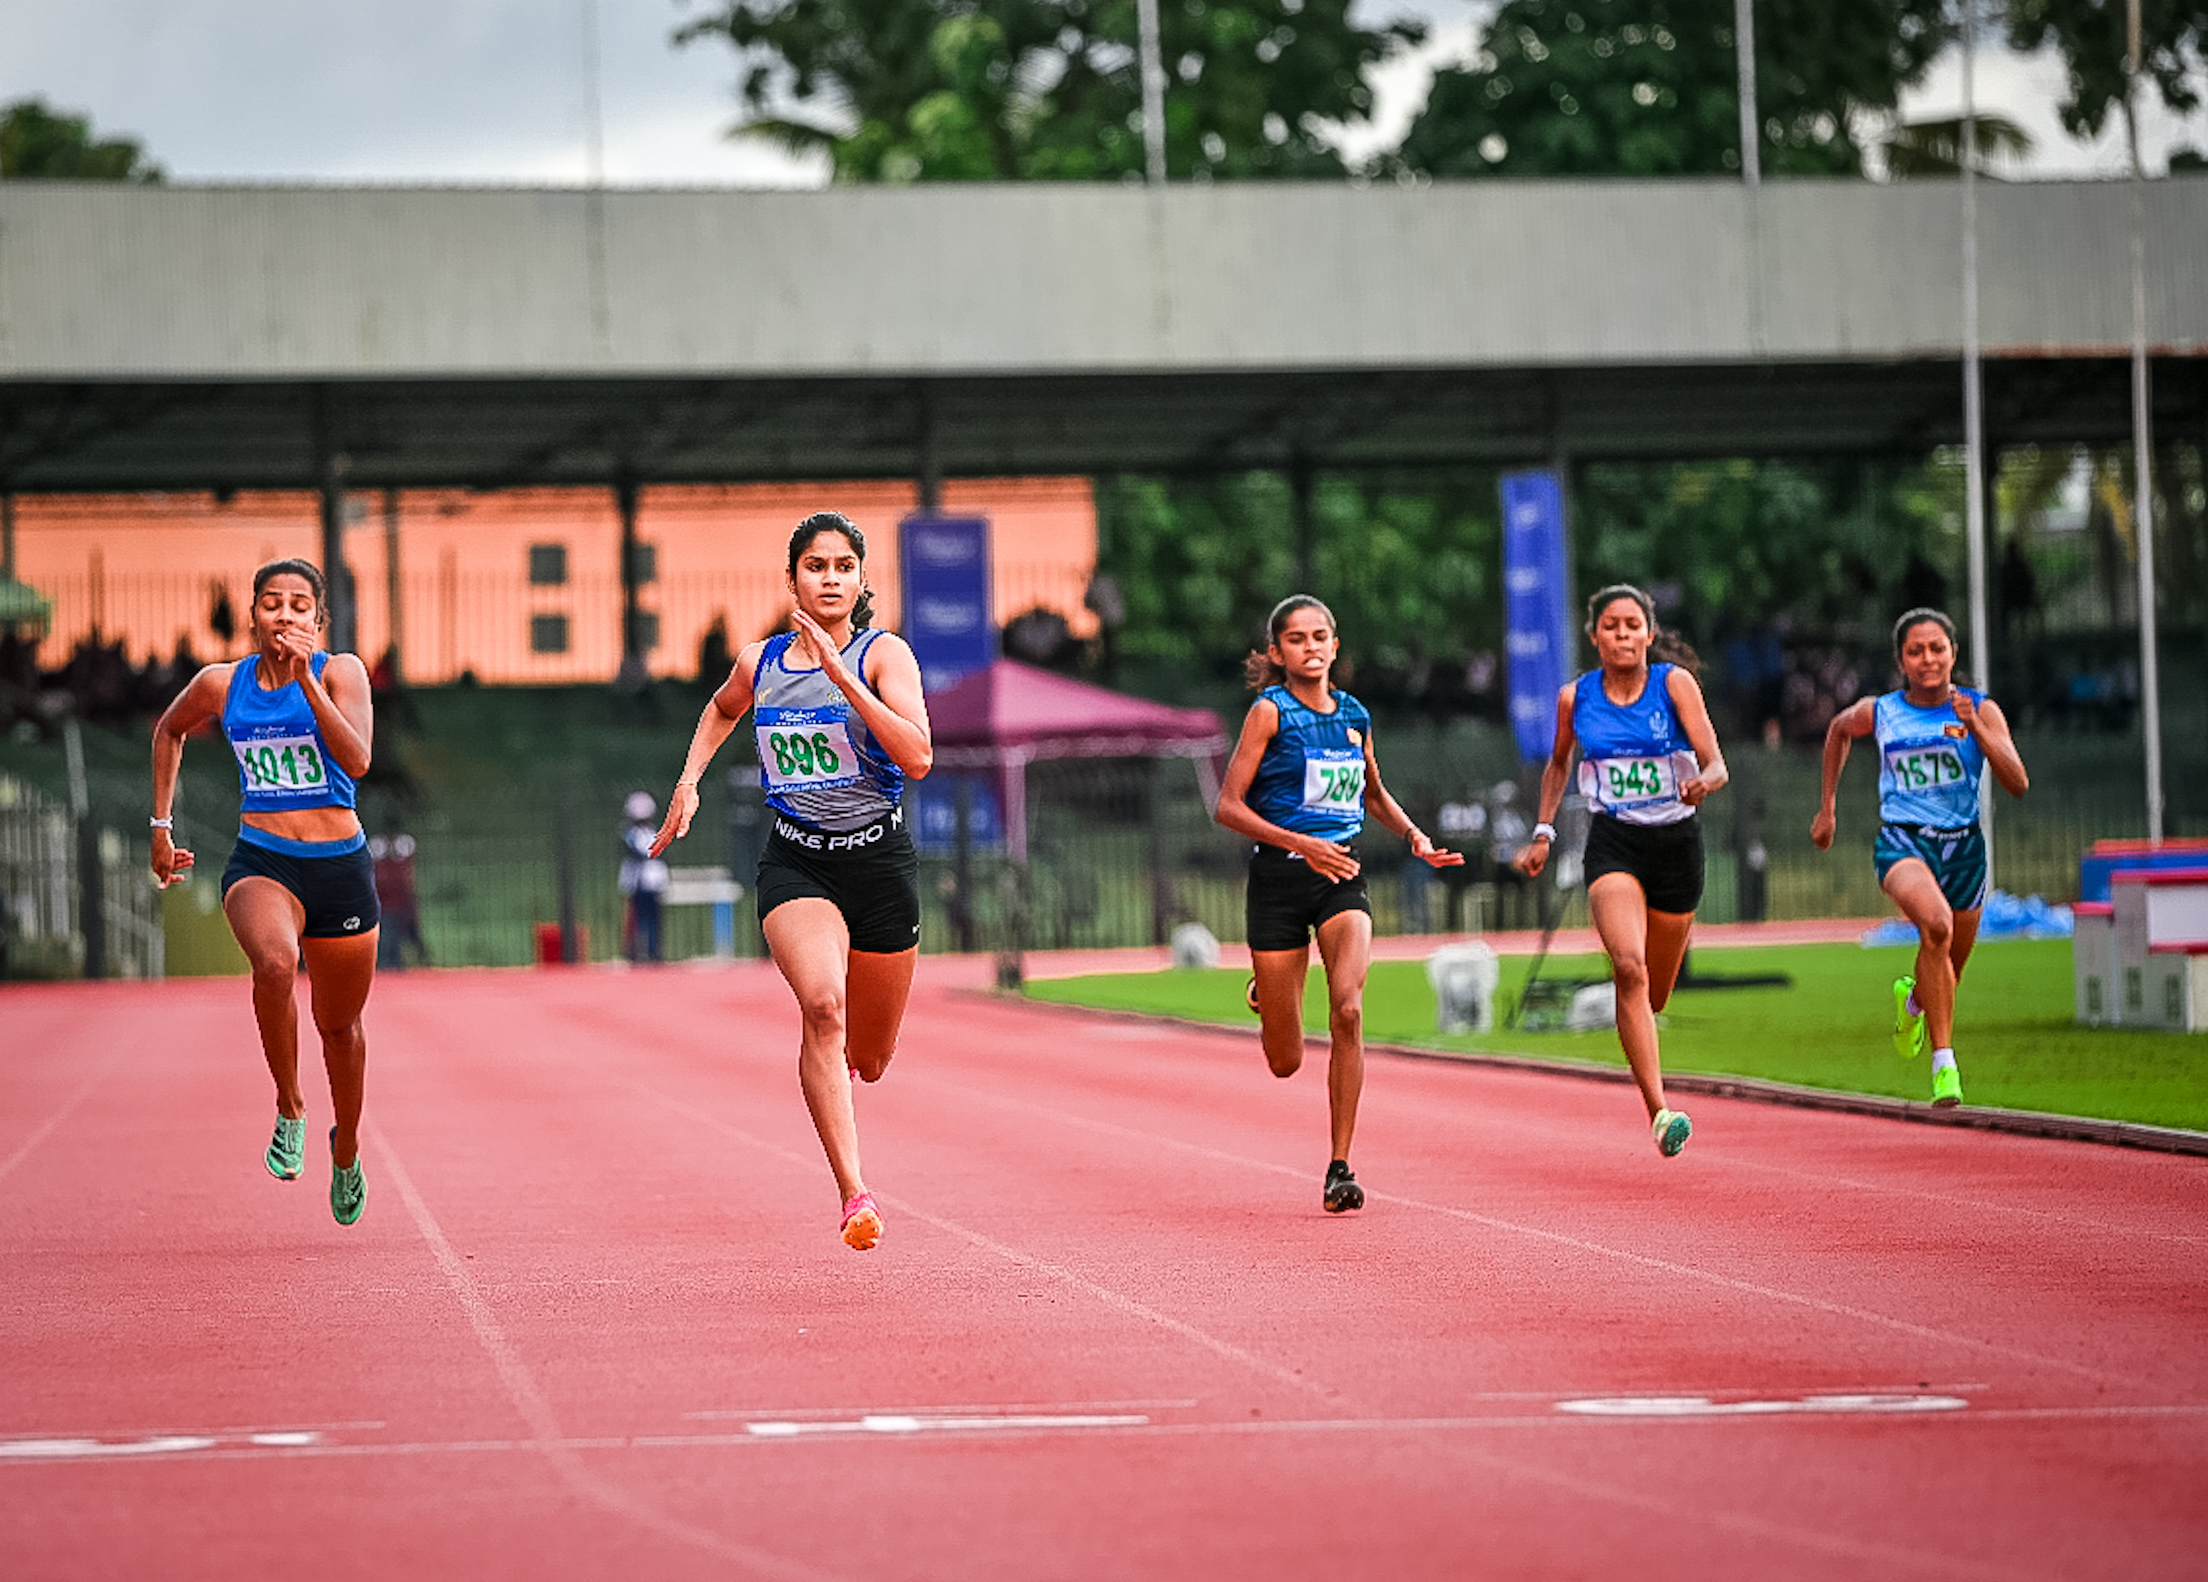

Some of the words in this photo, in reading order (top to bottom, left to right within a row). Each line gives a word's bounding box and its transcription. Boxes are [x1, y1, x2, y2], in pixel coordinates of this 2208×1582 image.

[245, 745, 322, 785] 1013
[770, 732, 839, 776] 896
[1896, 751, 1962, 791] 1579
[1609, 760, 1661, 798] 943
[776, 817, 824, 850] NIKE
[828, 825, 884, 850] PRO
